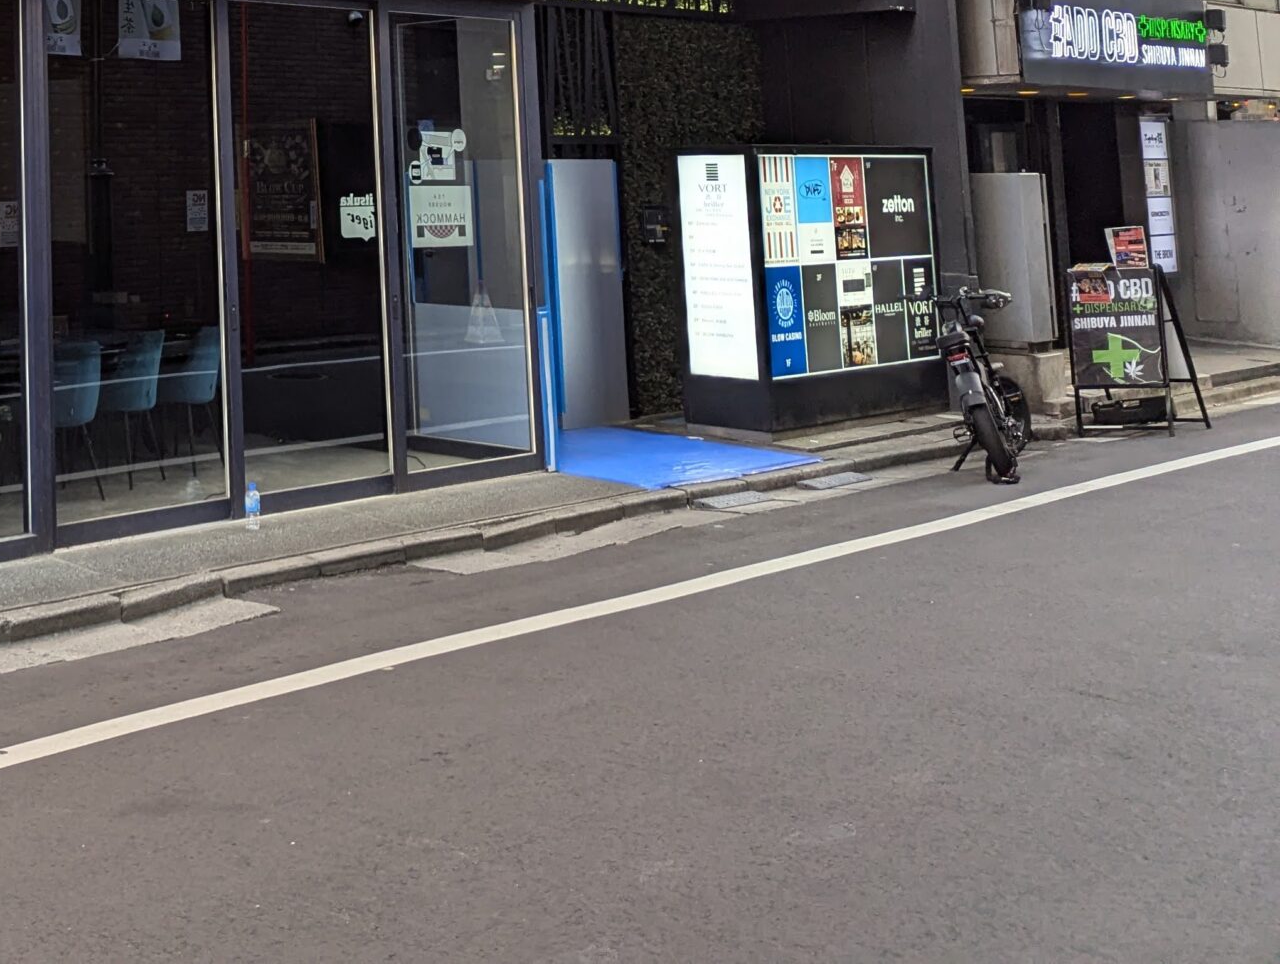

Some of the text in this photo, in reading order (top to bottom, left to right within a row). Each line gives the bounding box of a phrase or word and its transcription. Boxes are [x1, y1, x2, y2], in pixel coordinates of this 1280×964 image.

[1102, 9, 1139, 63] CBD
[1142, 44, 1206, 68] SHIBUYA JINNAN
[698, 183, 727, 193] VORT
[882, 195, 915, 213] zetton
[1119, 277, 1153, 299] CBD
[875, 302, 904, 313] HALLEL
[1084, 301, 1142, 314] DISPENSARY
[813, 310, 836, 322] Bloom
[1074, 314, 1156, 330] SHIBUYA JINNAN
